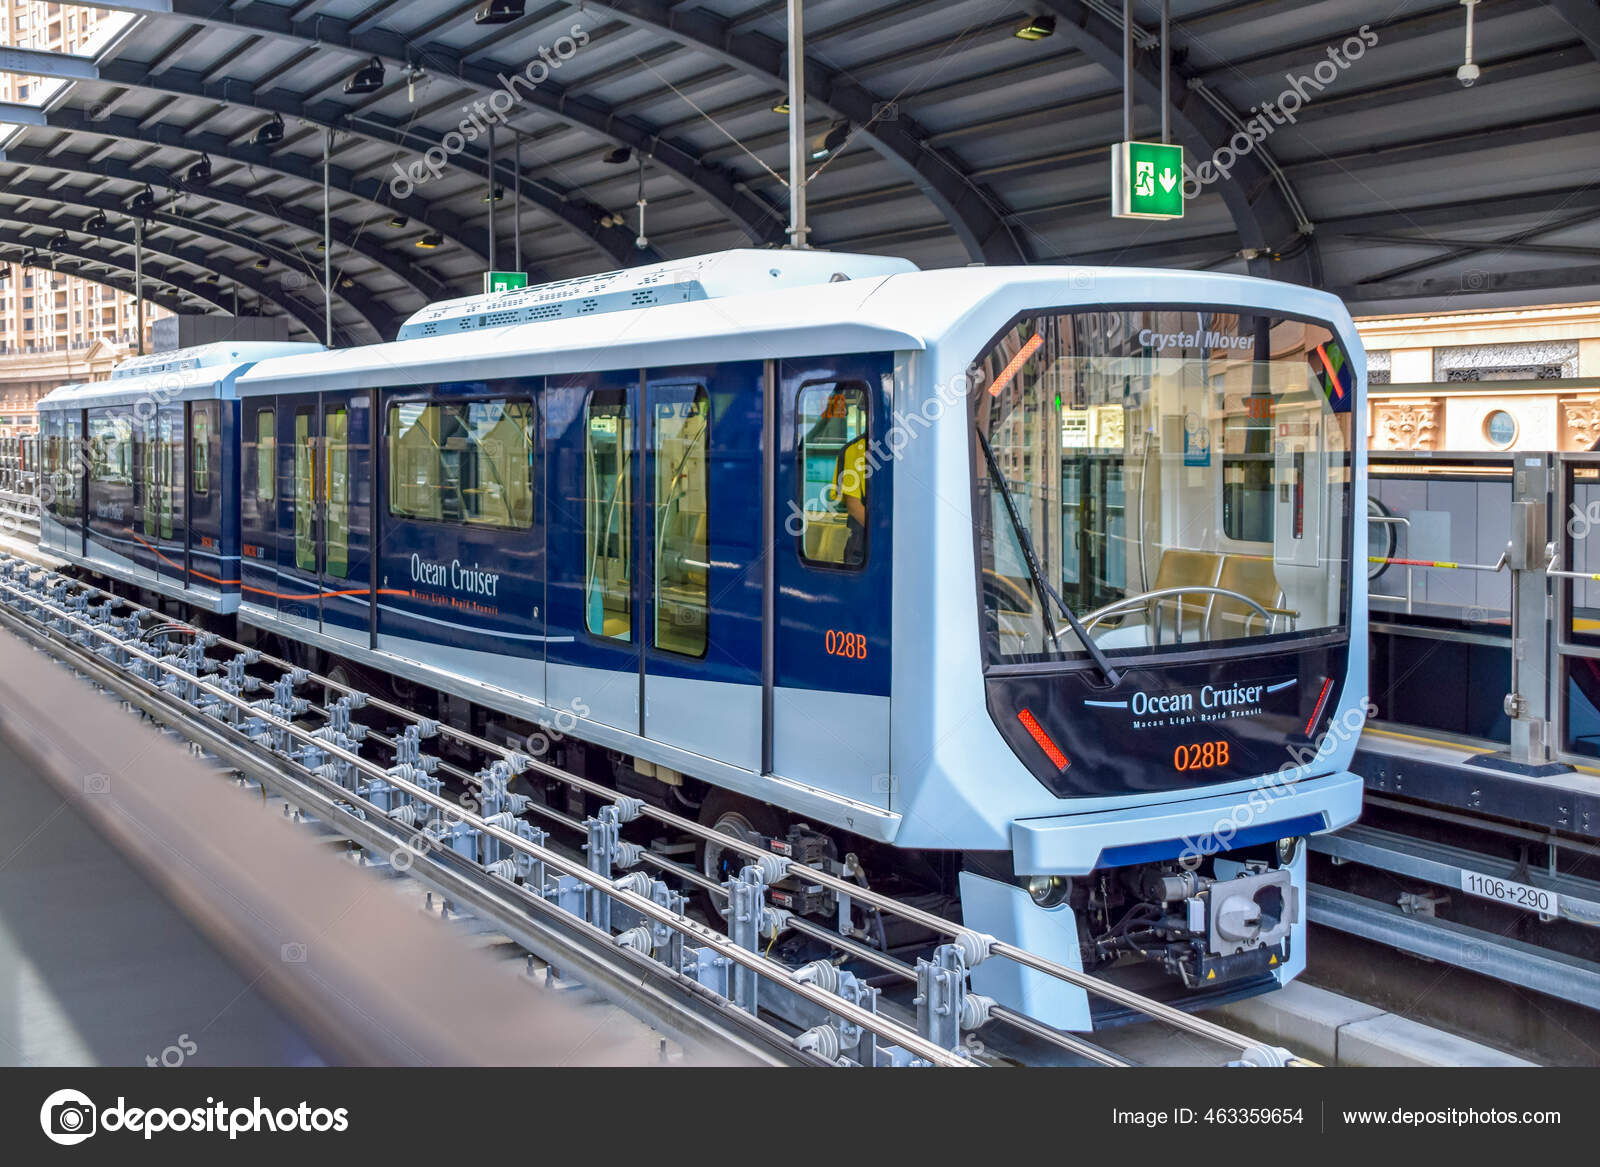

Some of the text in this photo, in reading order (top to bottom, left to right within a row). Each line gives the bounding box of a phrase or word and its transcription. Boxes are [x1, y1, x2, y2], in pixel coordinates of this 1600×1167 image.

[1138, 328, 1255, 352] Crystal Mover
[411, 553, 499, 597] Ocean Cruiser
[825, 629, 867, 660] 028B
[1132, 682, 1263, 715] Ocean Cruiser
[1133, 707, 1262, 729] Macau Light Rapid Transit
[1174, 740, 1230, 772] 028B
[1468, 874, 1549, 910] 1106+290
